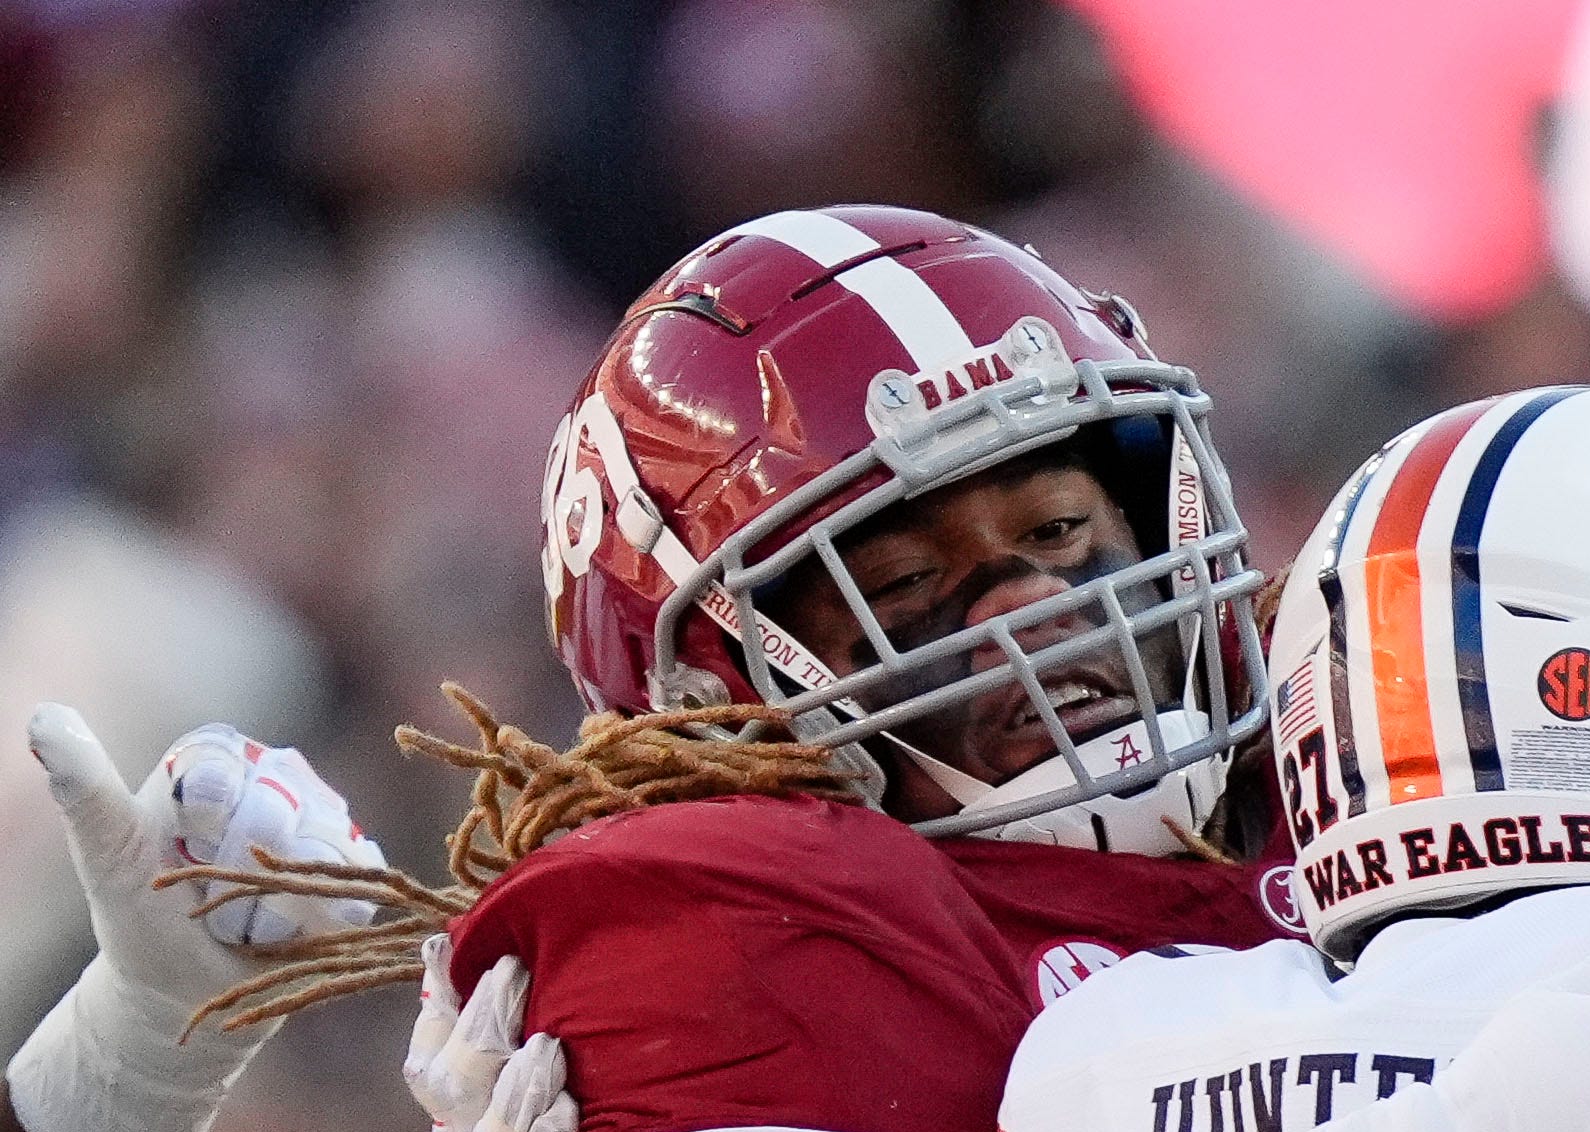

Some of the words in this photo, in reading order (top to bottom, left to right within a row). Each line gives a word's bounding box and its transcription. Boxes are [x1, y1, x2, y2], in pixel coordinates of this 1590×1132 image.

[917, 352, 1014, 410] BAMA
[1283, 724, 1339, 851] 27
[1303, 837, 1395, 911] WAR
